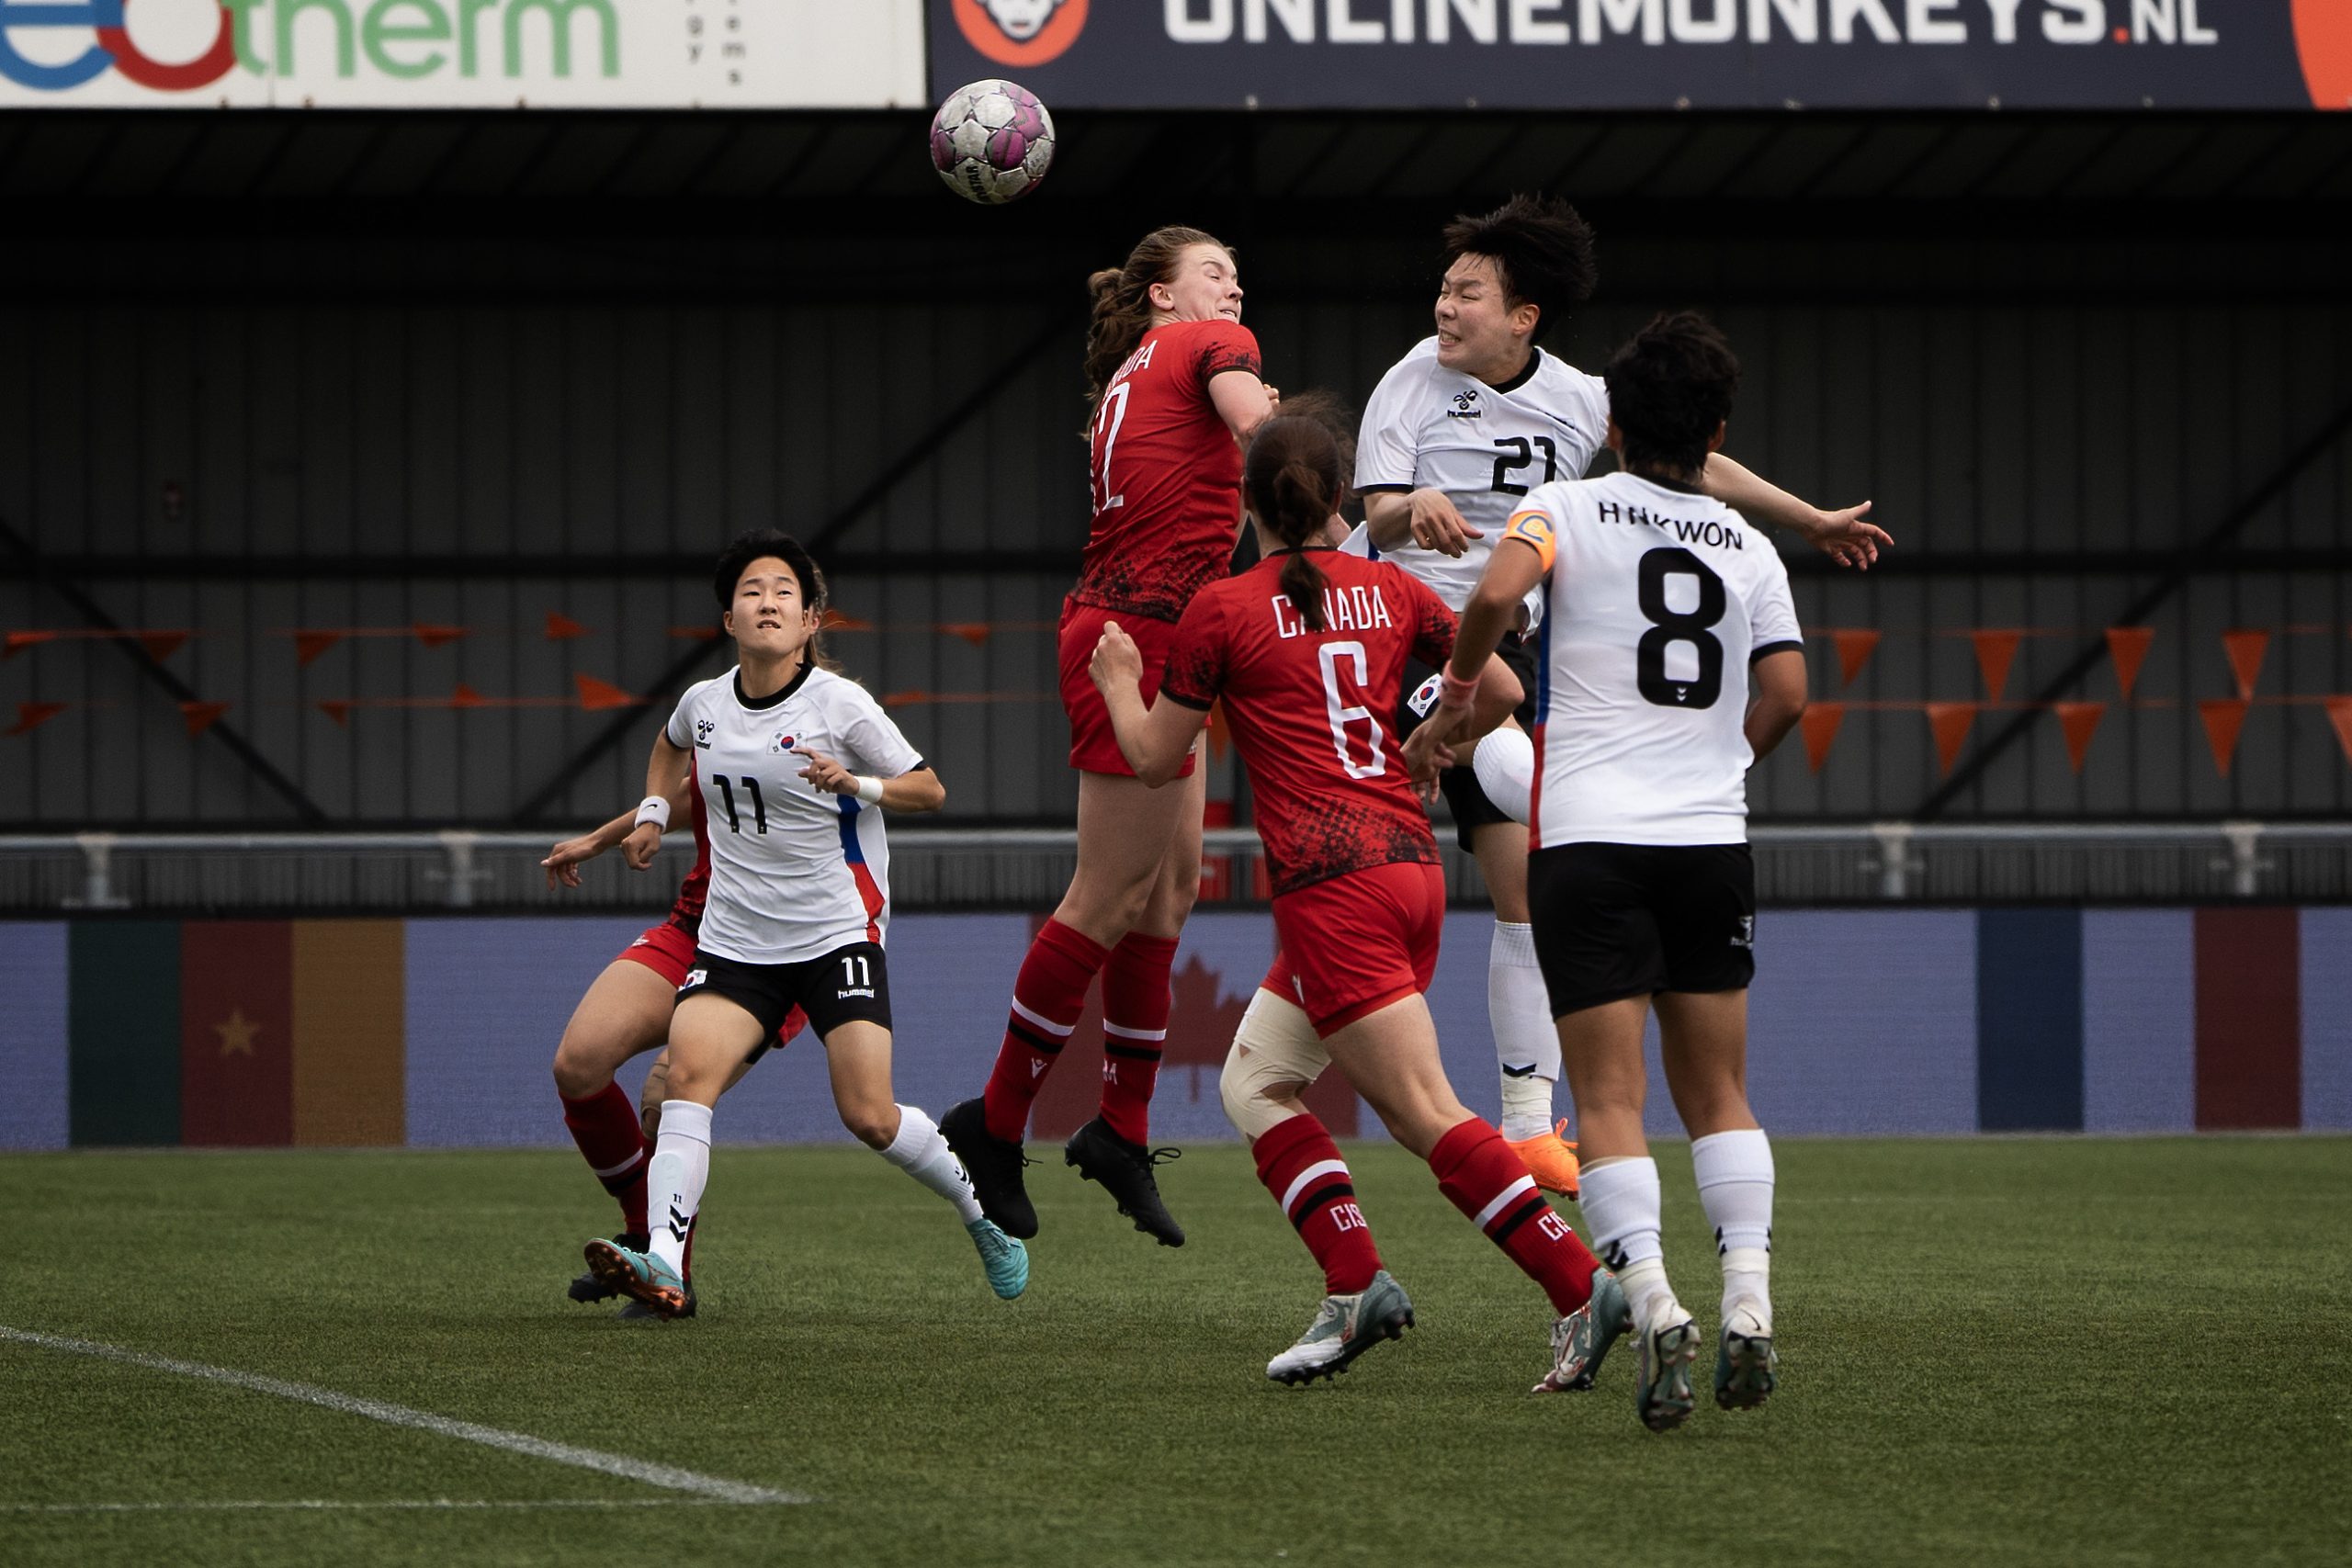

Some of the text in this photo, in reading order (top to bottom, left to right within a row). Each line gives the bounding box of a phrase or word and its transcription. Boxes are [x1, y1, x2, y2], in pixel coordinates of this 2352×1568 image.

[1446, 409, 1482, 419] hummel
[1490, 435, 1558, 497] 21
[1272, 585, 1392, 638] CNADA
[1636, 547, 1726, 710] 8
[1318, 641, 1386, 779] 6
[712, 773, 768, 835] 11
[837, 988, 875, 999] hummel
[841, 956, 870, 986] 11
[673, 1193, 683, 1204] 11
